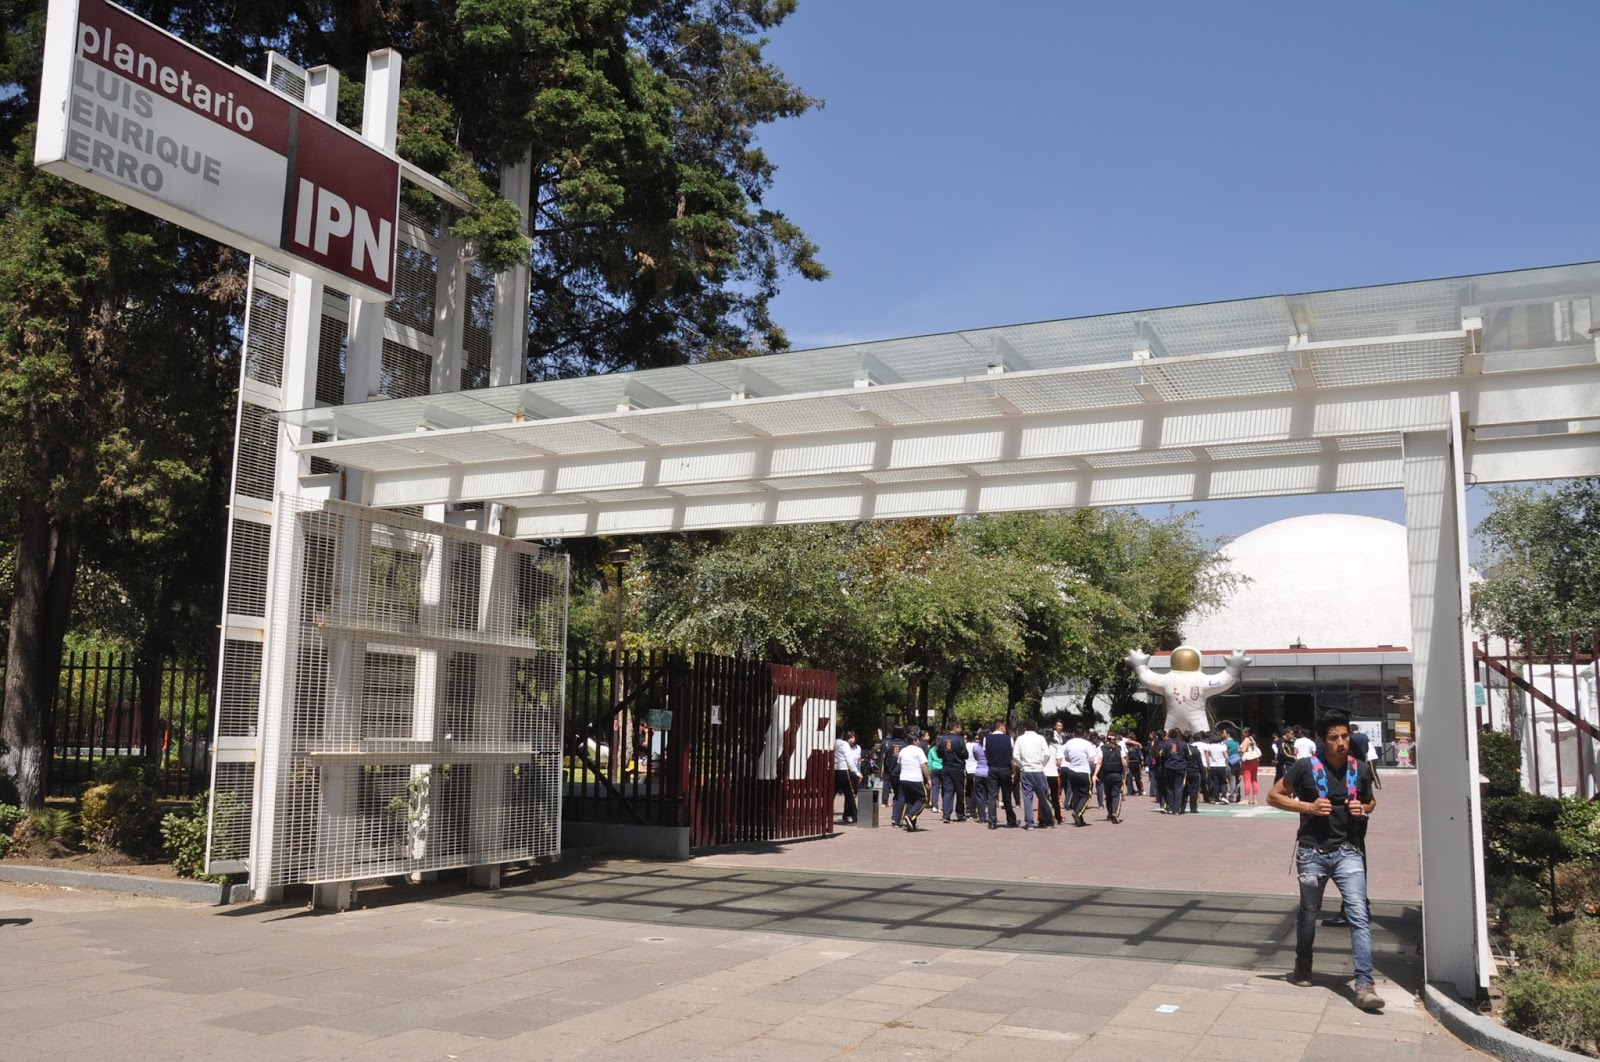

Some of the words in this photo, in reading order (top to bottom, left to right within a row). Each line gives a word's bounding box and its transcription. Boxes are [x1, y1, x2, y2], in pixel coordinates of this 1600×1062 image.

[74, 60, 153, 119] LUIS
[78, 22, 254, 132] planetario
[68, 130, 163, 193] ERRO
[71, 95, 222, 186] ENRIQUE
[294, 177, 392, 283] IPN
